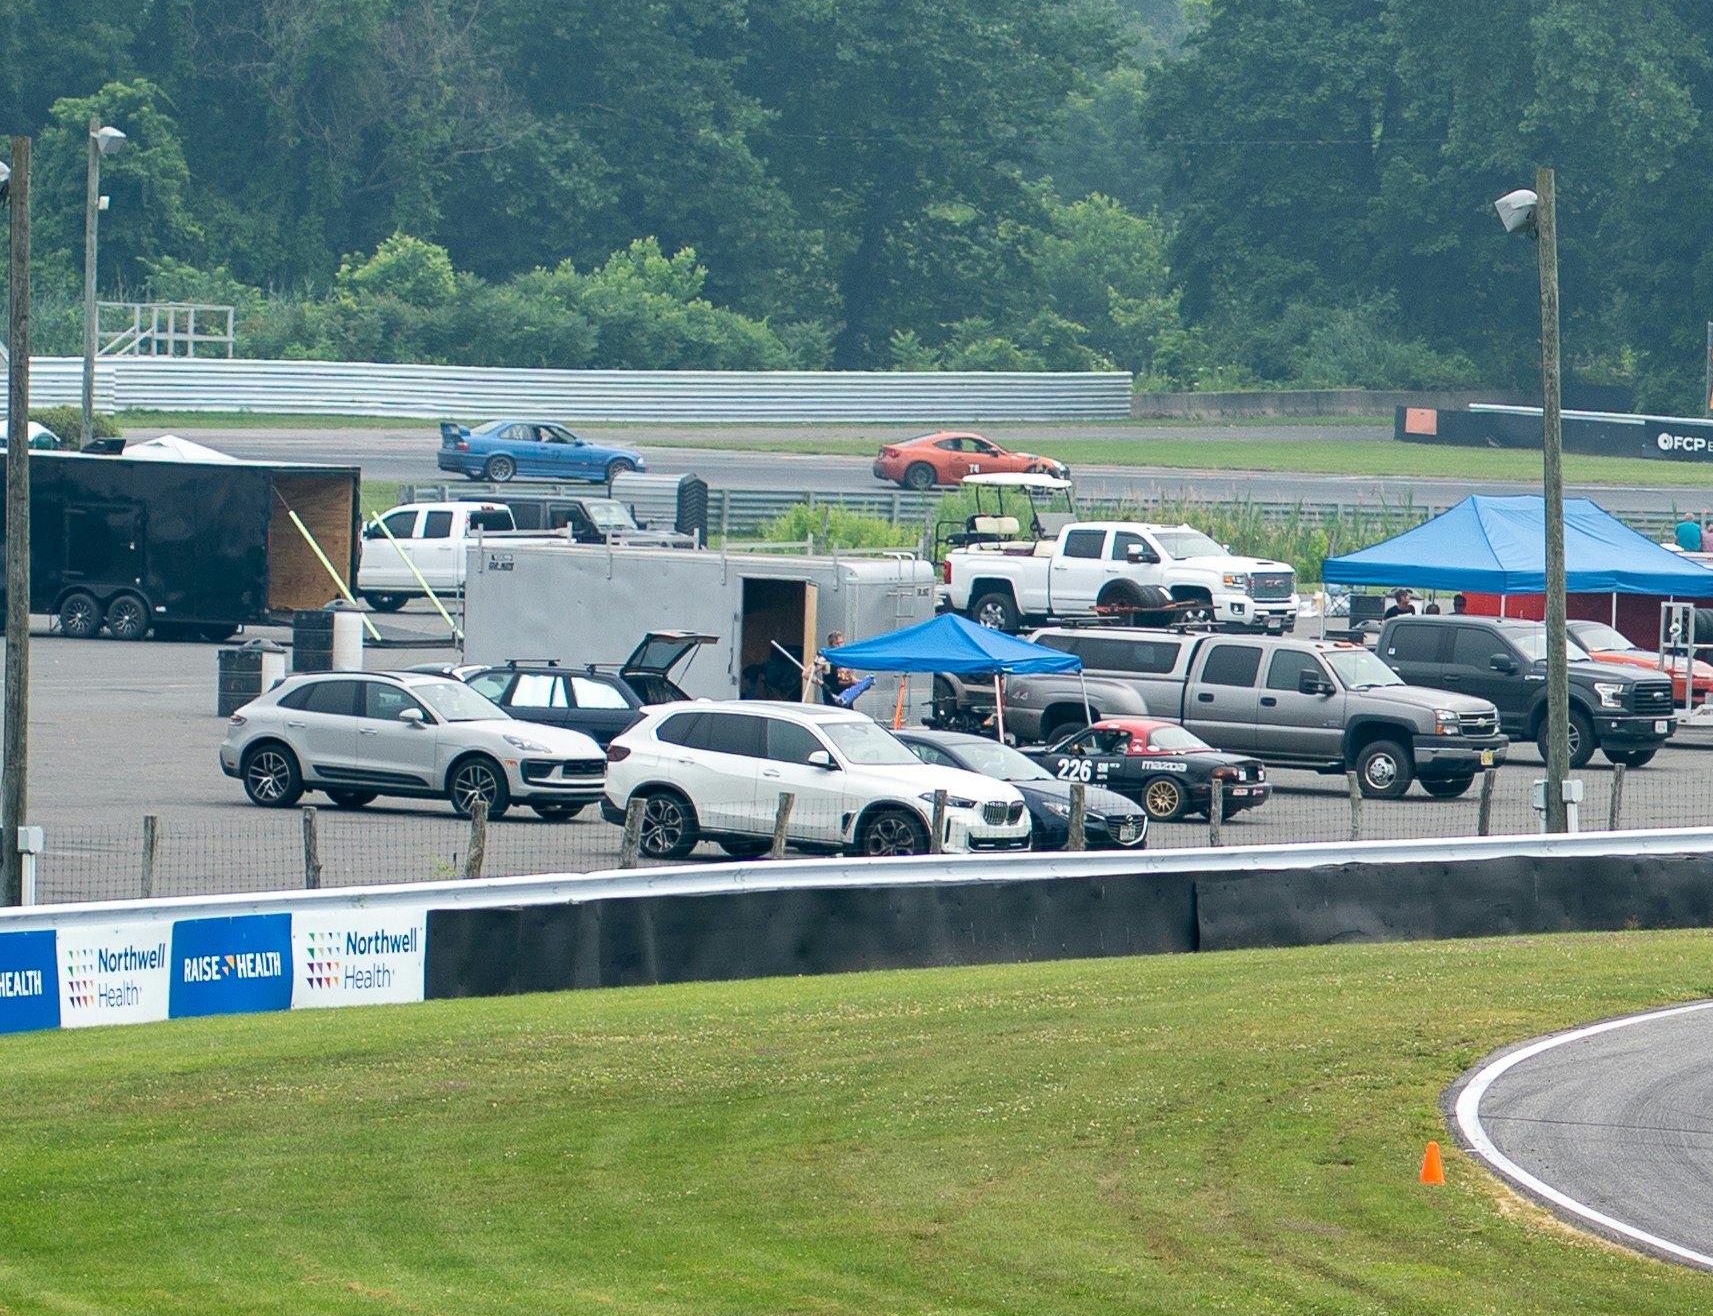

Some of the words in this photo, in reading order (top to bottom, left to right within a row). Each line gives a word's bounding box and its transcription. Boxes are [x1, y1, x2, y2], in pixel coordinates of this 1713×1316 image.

[1673, 435, 1706, 452] FCP
[1057, 758, 1093, 782] 226
[345, 927, 418, 956] Northwell
[98, 942, 166, 974] Northwell
[183, 955, 221, 983] RAISE
[236, 952, 282, 978] HEALTH
[344, 963, 391, 990] Health
[98, 980, 139, 1009] Health
